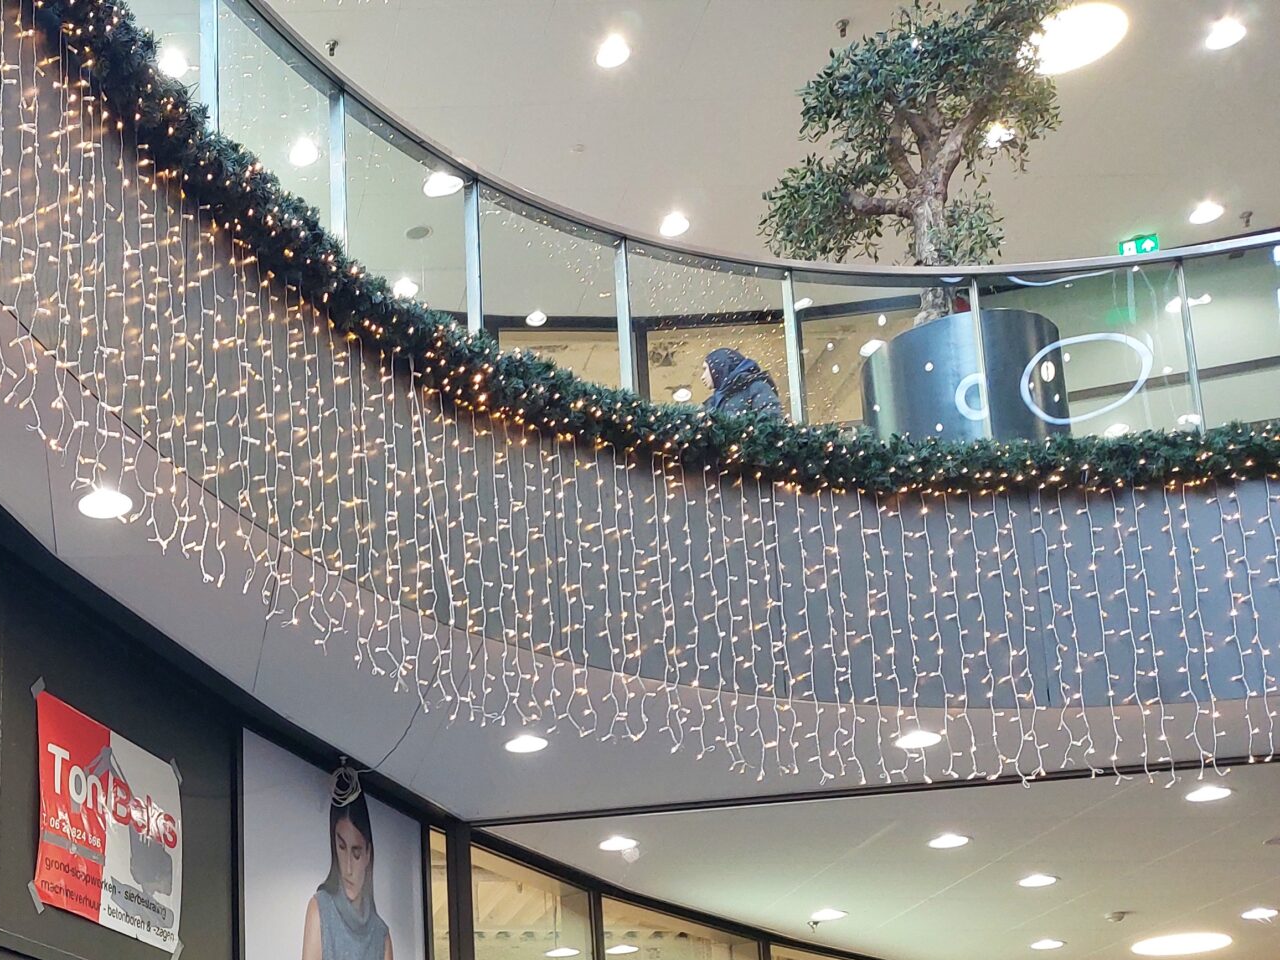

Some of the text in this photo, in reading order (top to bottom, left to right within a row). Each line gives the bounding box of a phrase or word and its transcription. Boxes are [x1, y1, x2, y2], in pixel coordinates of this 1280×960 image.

[47, 743, 178, 849] Ton Beks
[49, 817, 60, 830] 06
[107, 903, 145, 931] betonboren
